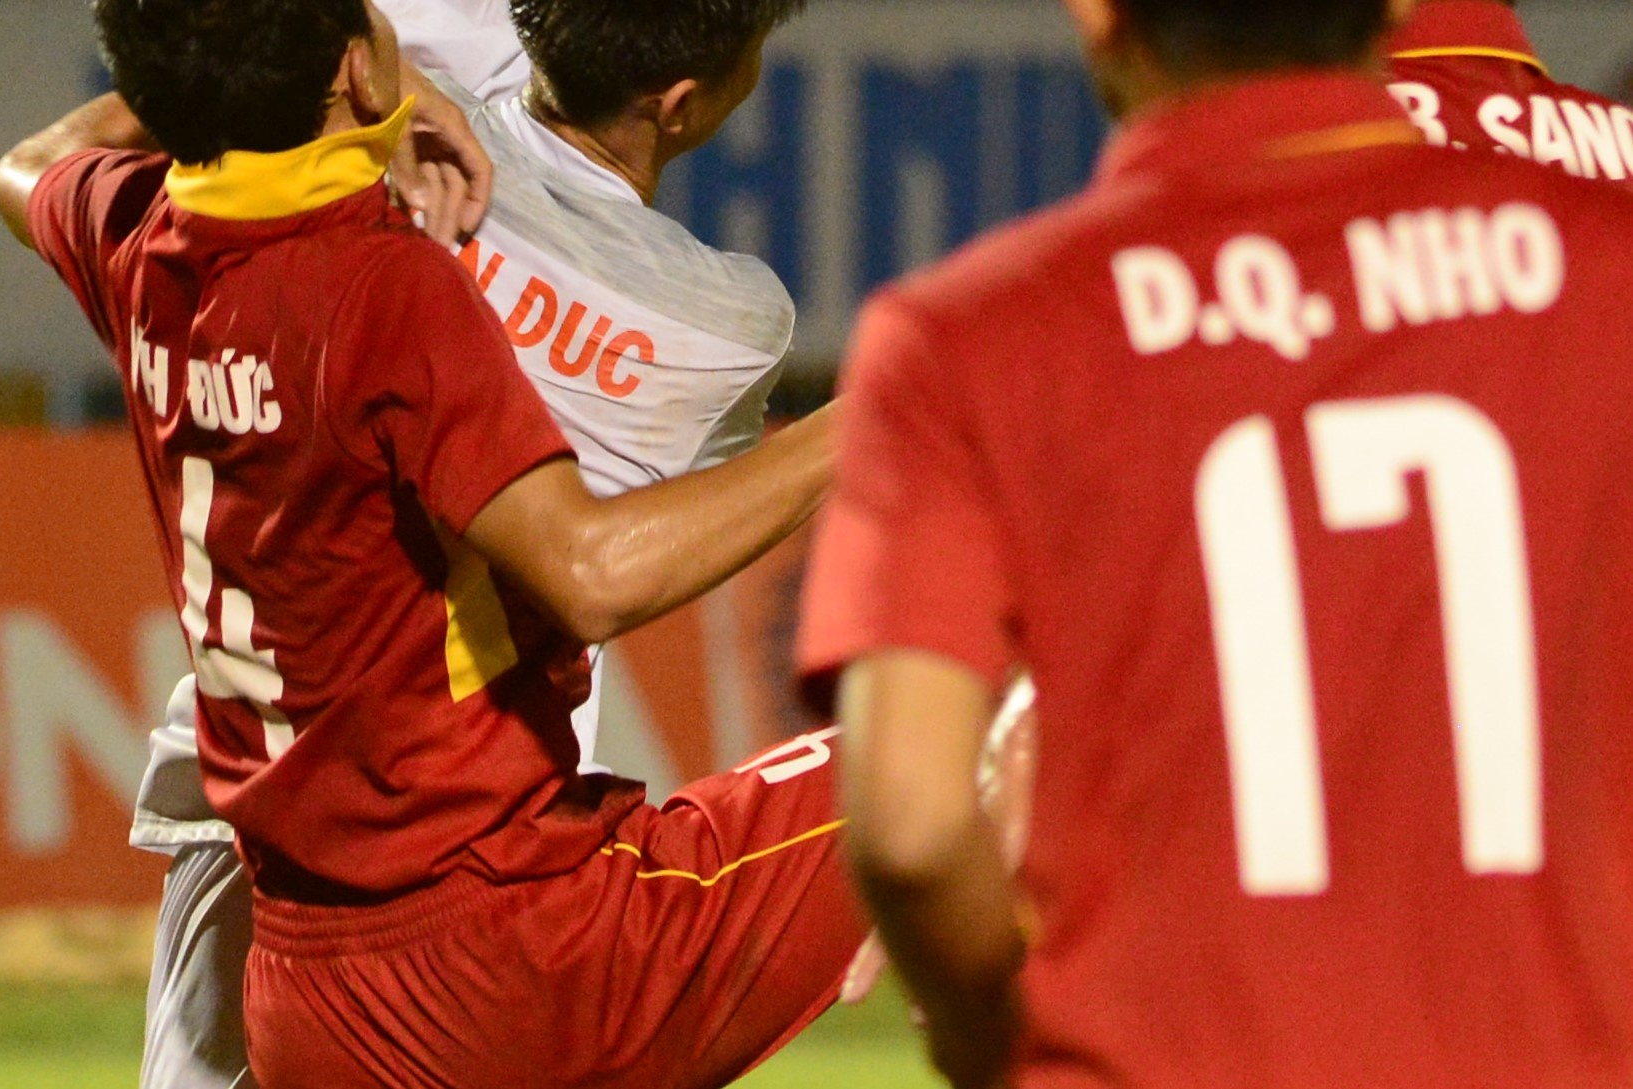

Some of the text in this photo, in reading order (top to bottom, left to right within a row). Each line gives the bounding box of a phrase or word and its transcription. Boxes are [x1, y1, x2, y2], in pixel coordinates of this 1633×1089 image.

[503, 275, 655, 398] DUC
[1111, 201, 1566, 361] D.Q. NHO
[186, 348, 282, 435] ĐỨC
[180, 456, 295, 764] 4
[1194, 392, 1545, 899] 17
